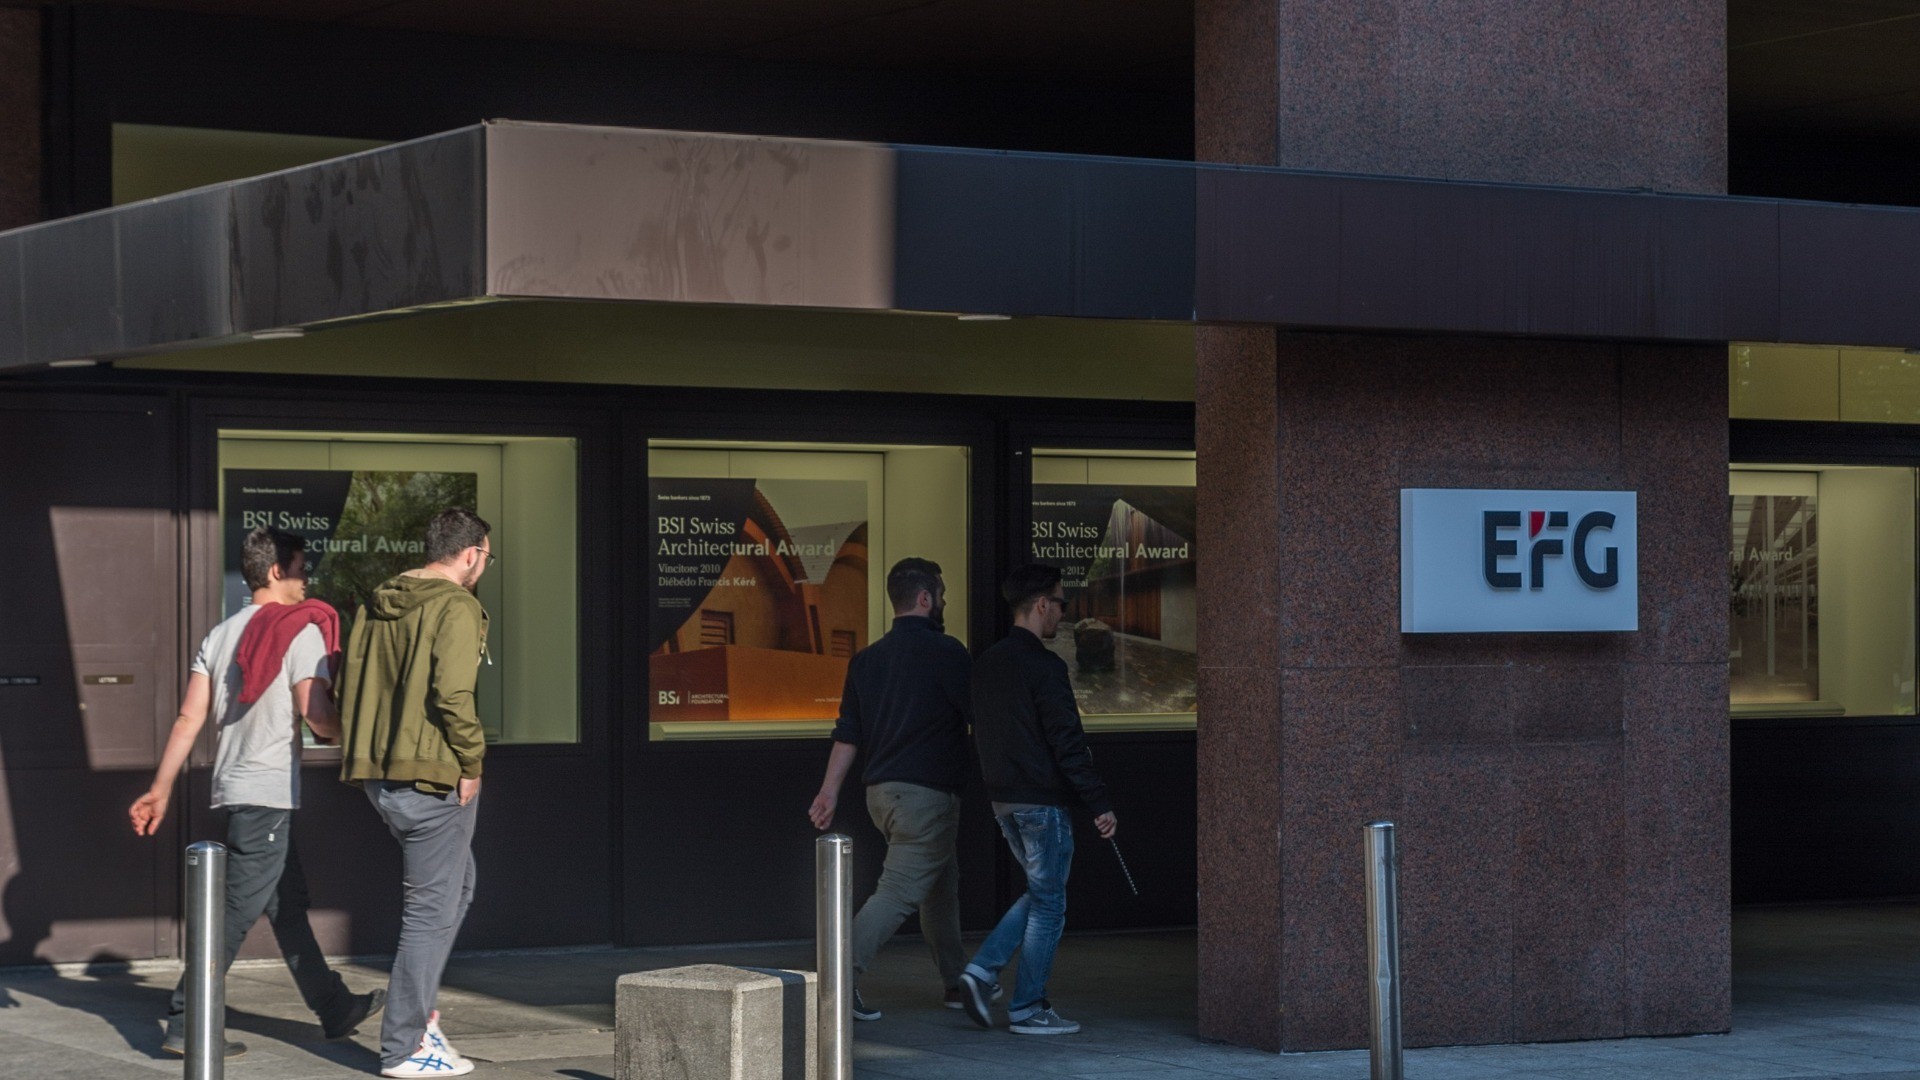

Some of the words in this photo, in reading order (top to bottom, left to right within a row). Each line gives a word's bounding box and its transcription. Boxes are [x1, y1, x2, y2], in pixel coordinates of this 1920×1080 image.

[242, 510, 273, 530] BSI
[278, 510, 330, 531] Swiss
[657, 517, 685, 535] BSI
[690, 517, 736, 535] Swiss
[1032, 521, 1053, 539] BSI
[1057, 521, 1099, 539] Swiss
[303, 534, 367, 553] ectural
[375, 535, 426, 554] Awar
[657, 538, 770, 556] Architectural
[775, 539, 835, 557] Award
[1032, 541, 1129, 559] Architectural
[1135, 542, 1189, 559] Award
[1483, 510, 1618, 590] EFG
[1749, 546, 1793, 561] Award
[658, 563, 698, 574] Vincitore
[700, 563, 721, 574] 2010
[1067, 566, 1085, 575] 2012
[658, 576, 697, 587] Diébédo
[698, 576, 731, 587] Francis
[733, 576, 756, 587] Kéré
